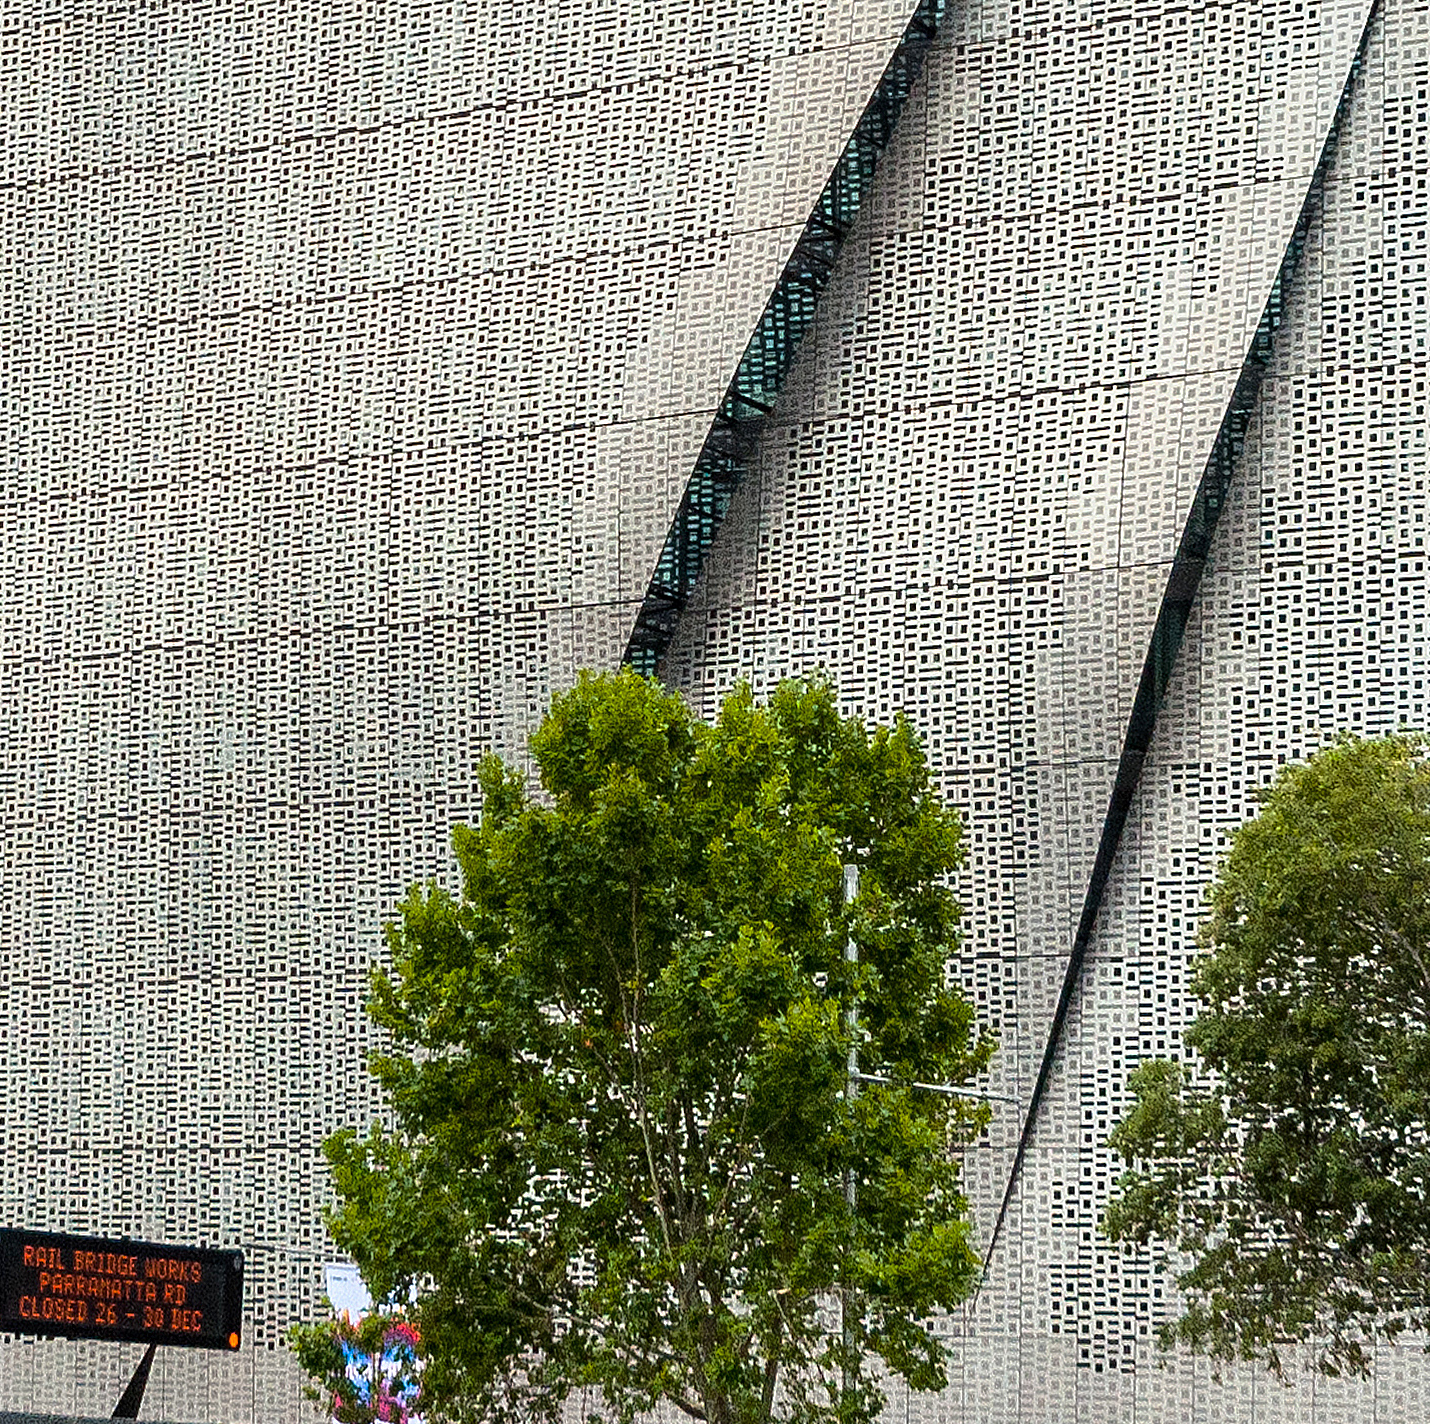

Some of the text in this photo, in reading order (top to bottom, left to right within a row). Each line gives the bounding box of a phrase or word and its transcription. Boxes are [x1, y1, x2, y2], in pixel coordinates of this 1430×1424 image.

[24, 1245, 202, 1283] RAIL BRIDGE WORKS
[39, 1272, 186, 1306] PARRAMATTA RD
[20, 1295, 88, 1322] CLOSED
[95, 1302, 118, 1324] 26
[144, 1306, 164, 1328] 30
[171, 1308, 203, 1332] DEC
